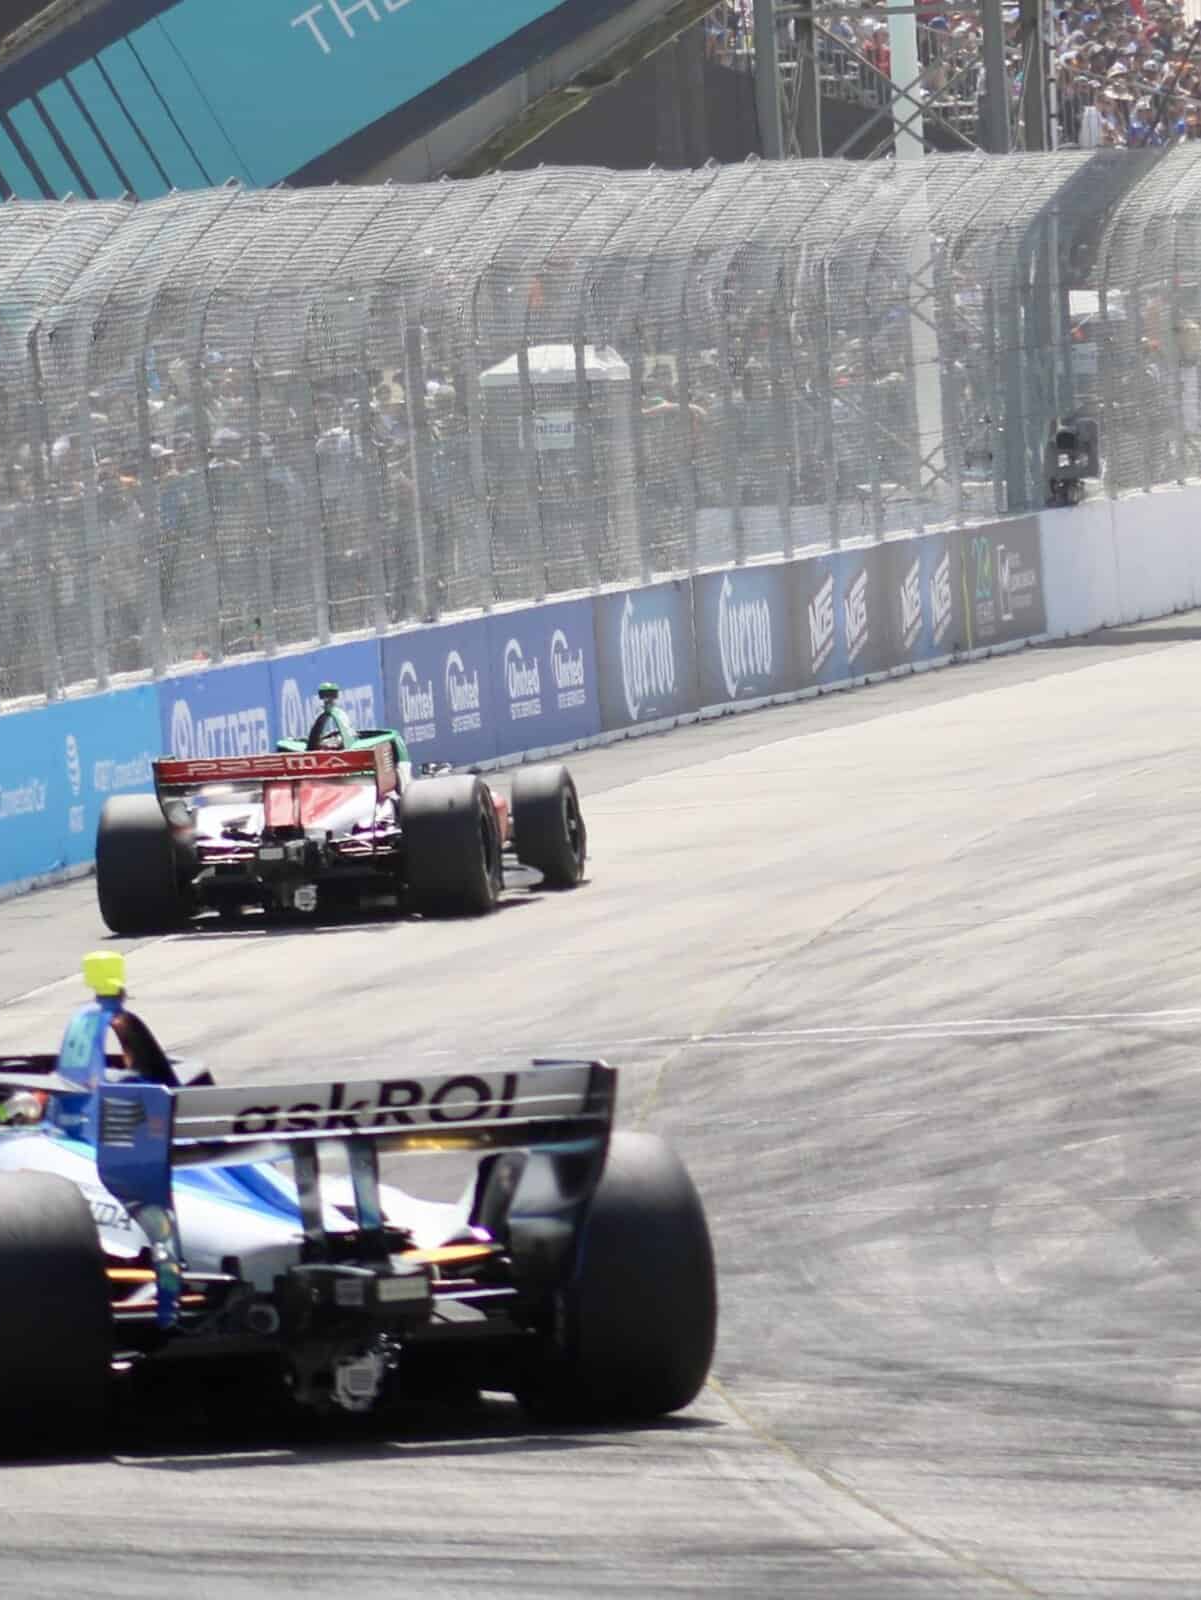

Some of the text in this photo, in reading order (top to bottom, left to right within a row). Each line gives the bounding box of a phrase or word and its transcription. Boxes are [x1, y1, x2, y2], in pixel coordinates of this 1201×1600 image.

[290, 0, 411, 53] TH
[620, 593, 675, 721] Cuervo
[719, 575, 773, 699] Cuervo
[186, 755, 351, 777] PREMA
[232, 1072, 519, 1135] askROI
